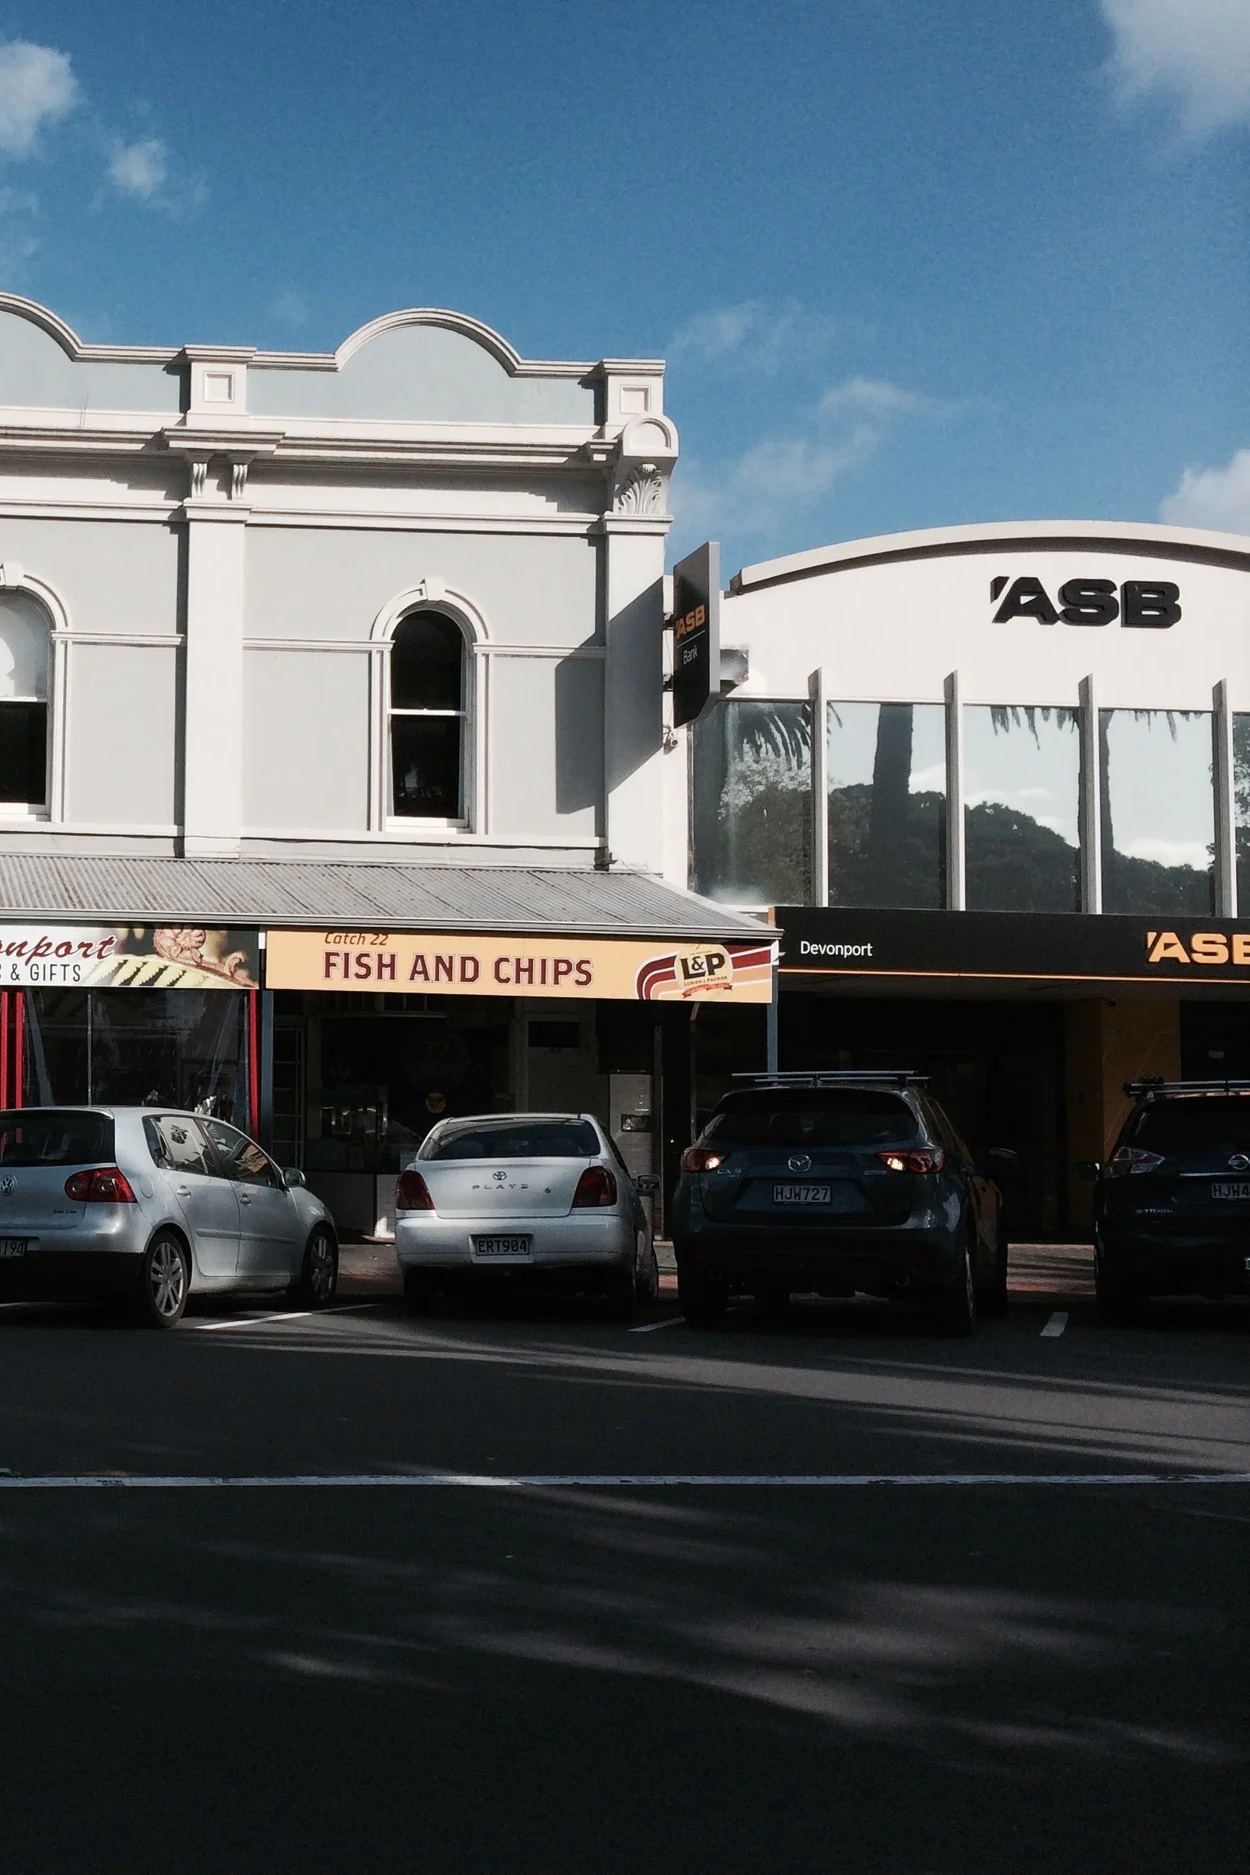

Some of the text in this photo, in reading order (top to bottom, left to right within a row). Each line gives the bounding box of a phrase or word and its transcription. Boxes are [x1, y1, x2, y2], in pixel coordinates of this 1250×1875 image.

[990, 576, 1182, 629] ASB
[675, 604, 705, 639] ASB
[683, 644, 698, 664] Bank
[324, 932, 389, 946] Catch 22
[800, 940, 873, 958] Devonport
[9, 962, 21, 978] &
[29, 962, 82, 979] GIFTS
[323, 951, 592, 985] FISH AND CHIPS
[680, 952, 725, 980] L&P
[774, 1185, 829, 1200] HJW727
[478, 1239, 527, 1253] ERT904
